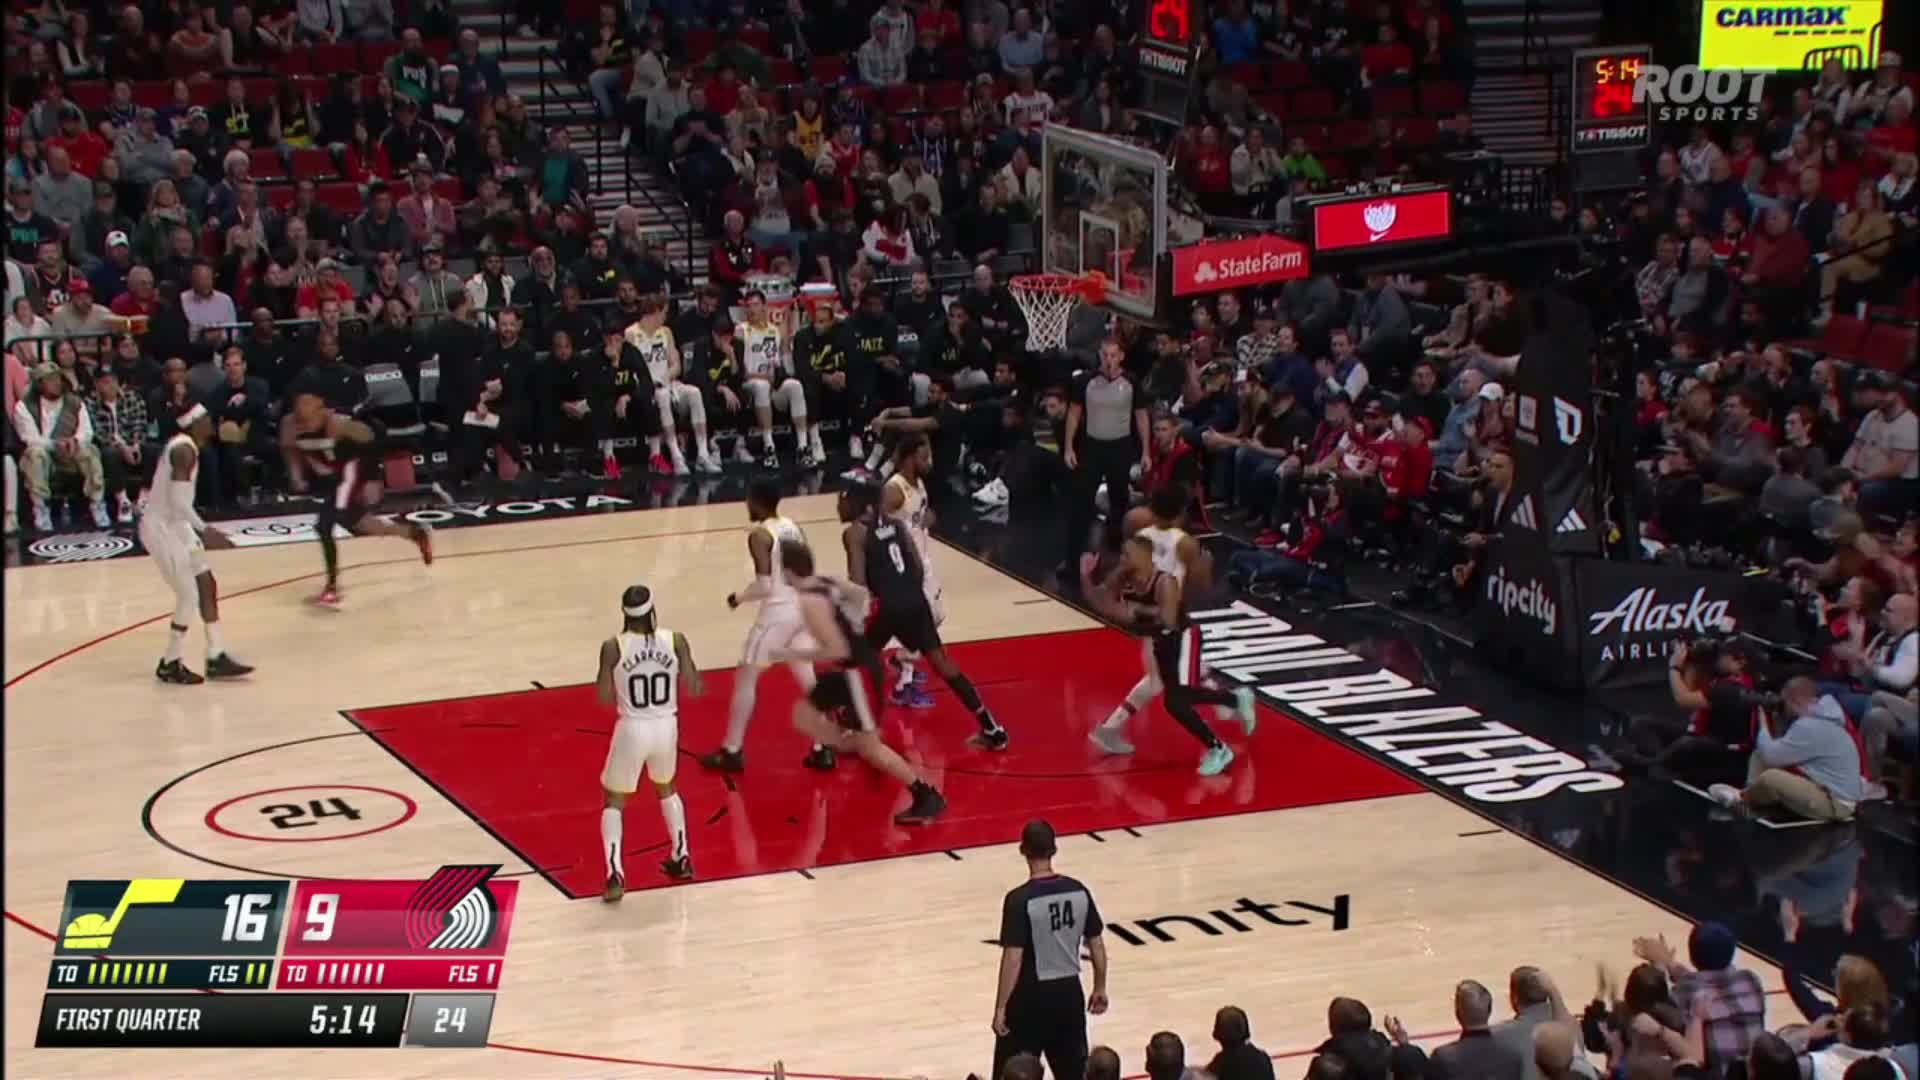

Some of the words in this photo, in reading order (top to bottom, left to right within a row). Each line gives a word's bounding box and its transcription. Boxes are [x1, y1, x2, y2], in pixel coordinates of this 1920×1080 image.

[1599, 125, 1647, 139] TISSOT
[888, 543, 905, 574] 9
[1487, 565, 1556, 635] ripcity
[1589, 587, 1730, 634] Alaska
[1187, 600, 1364, 682] TRAIL
[1601, 643, 1687, 661] AIRLI
[628, 672, 671, 709] 00
[1256, 668, 1624, 803] BLAZERS
[258, 797, 362, 829] 24
[1048, 900, 1076, 931] 24
